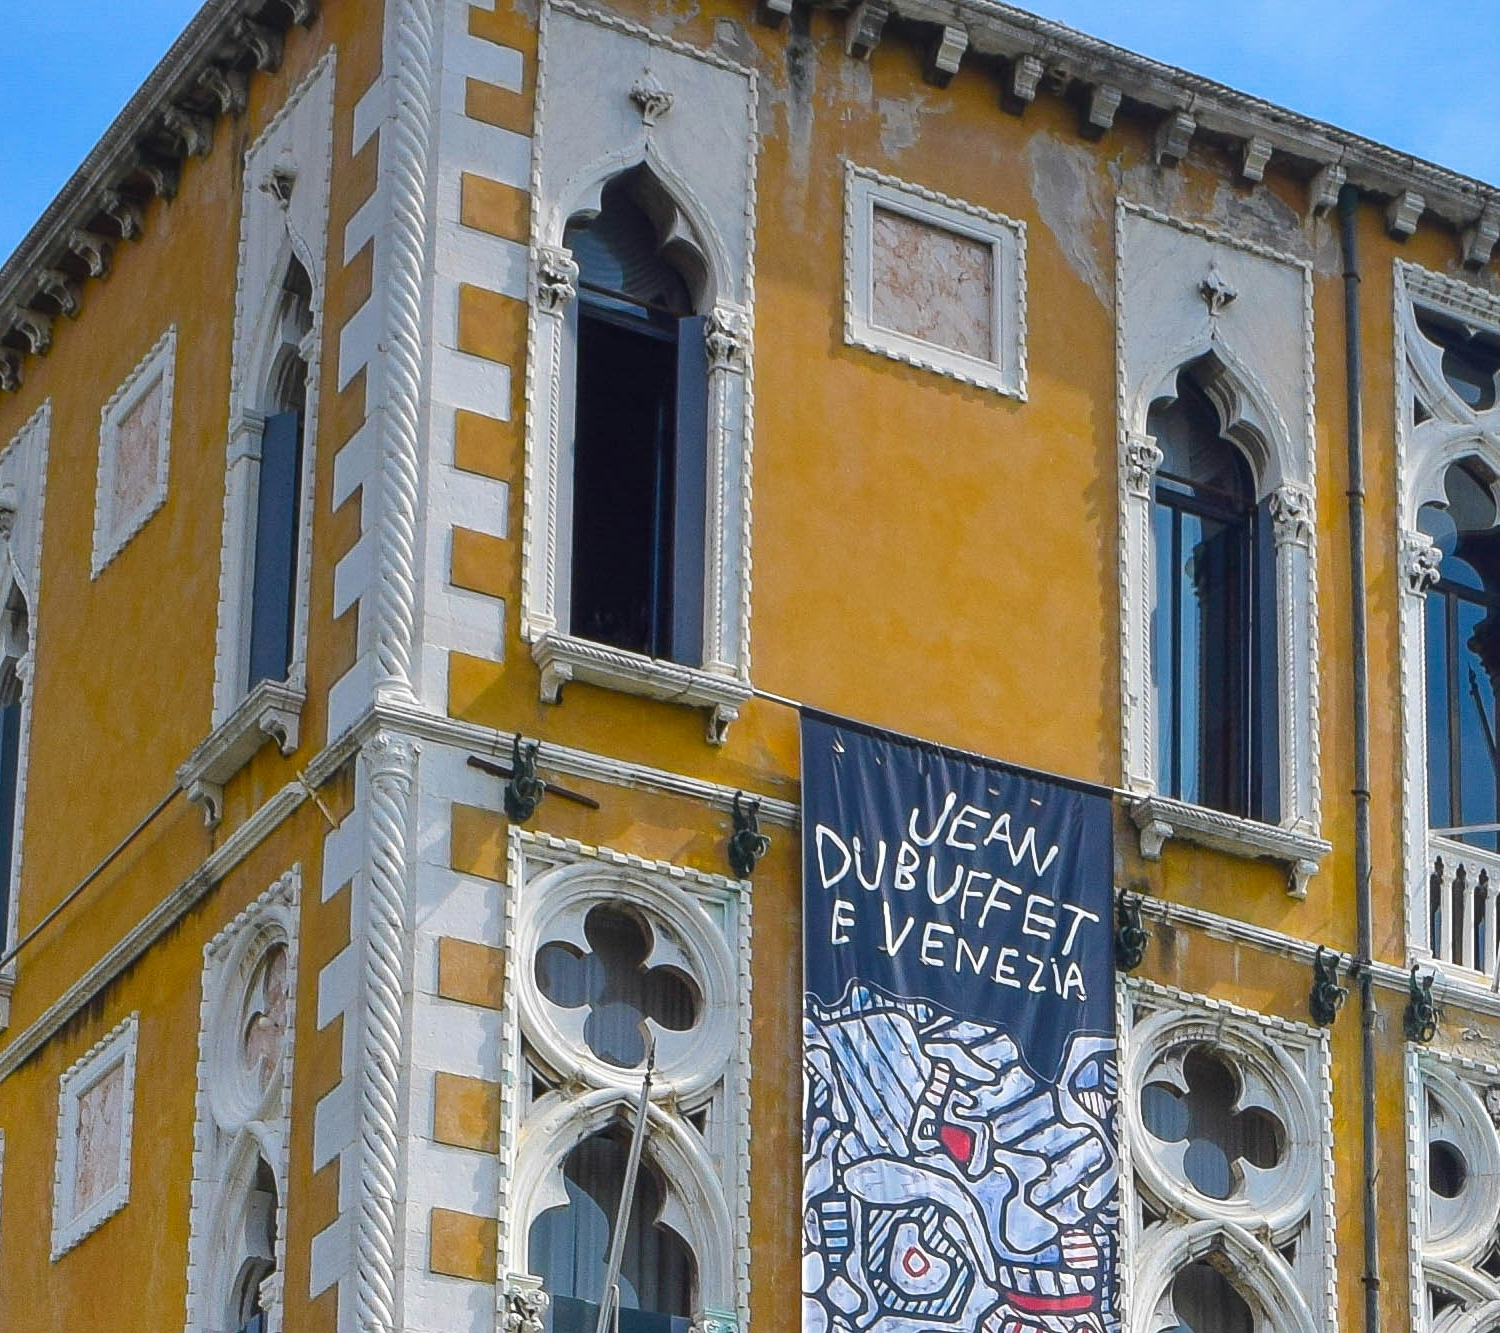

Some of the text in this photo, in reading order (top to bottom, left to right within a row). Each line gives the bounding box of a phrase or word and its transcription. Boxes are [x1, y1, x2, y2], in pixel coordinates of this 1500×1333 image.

[908, 792, 1058, 876] JEAN
[815, 823, 1100, 956] DUBUFFET
[831, 899, 855, 945] E
